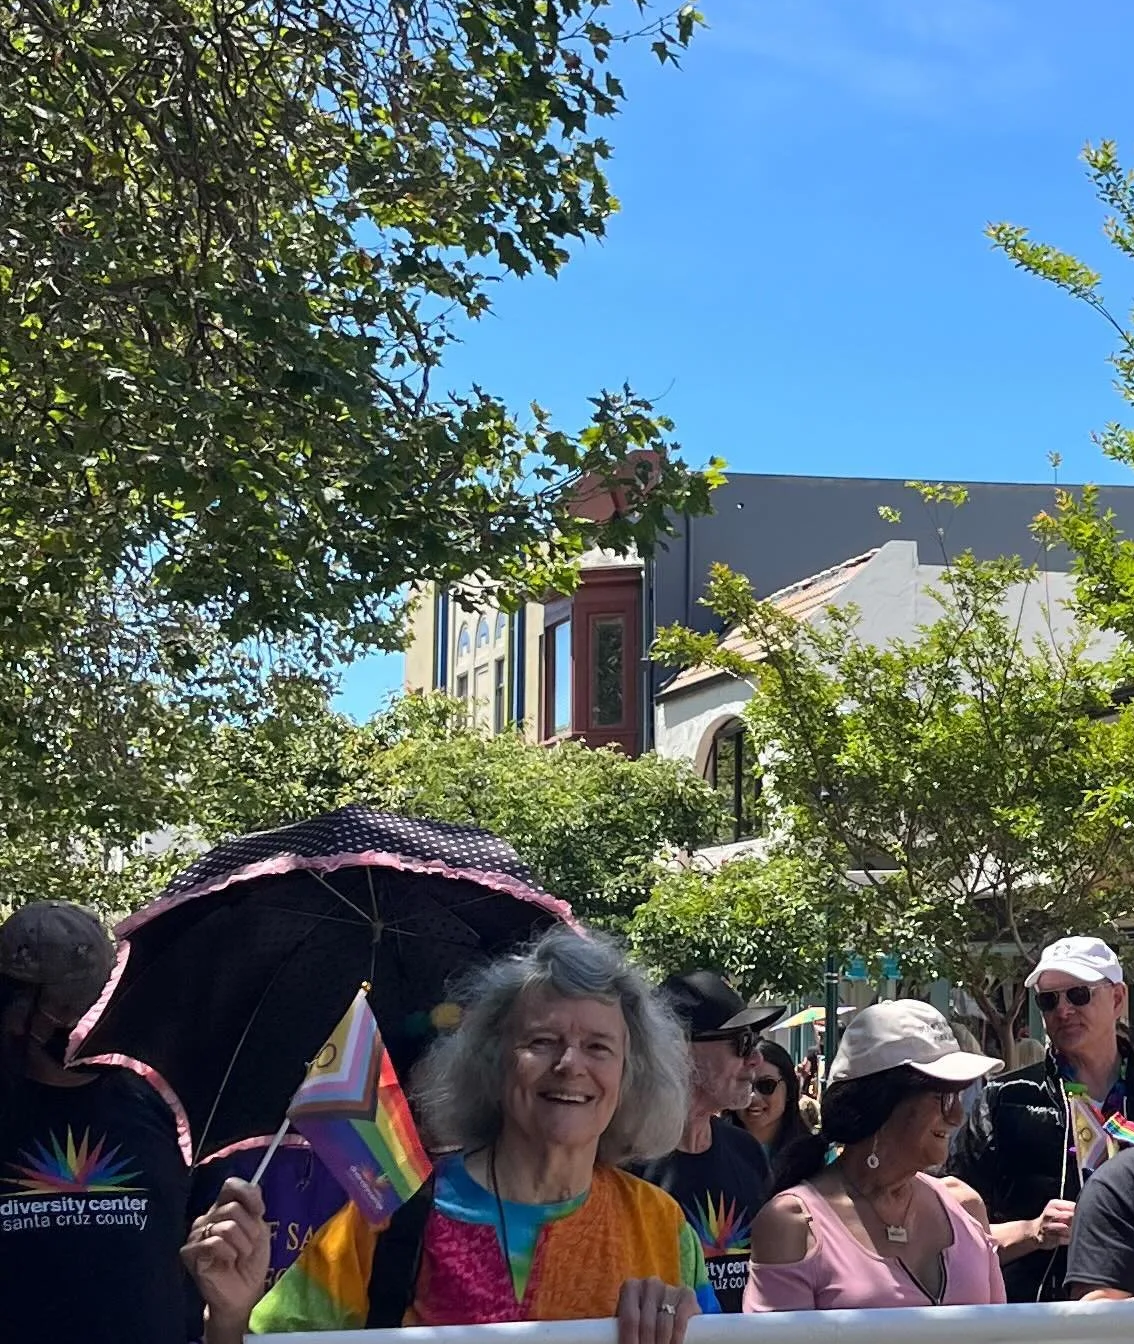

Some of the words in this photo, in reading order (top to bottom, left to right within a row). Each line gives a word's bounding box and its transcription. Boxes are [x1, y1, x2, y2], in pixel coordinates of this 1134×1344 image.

[0, 1196, 86, 1216] diversity
[89, 1196, 149, 1211] center
[3, 1213, 50, 1231] santa
[56, 1213, 91, 1226] cruz
[96, 1211, 148, 1230] county
